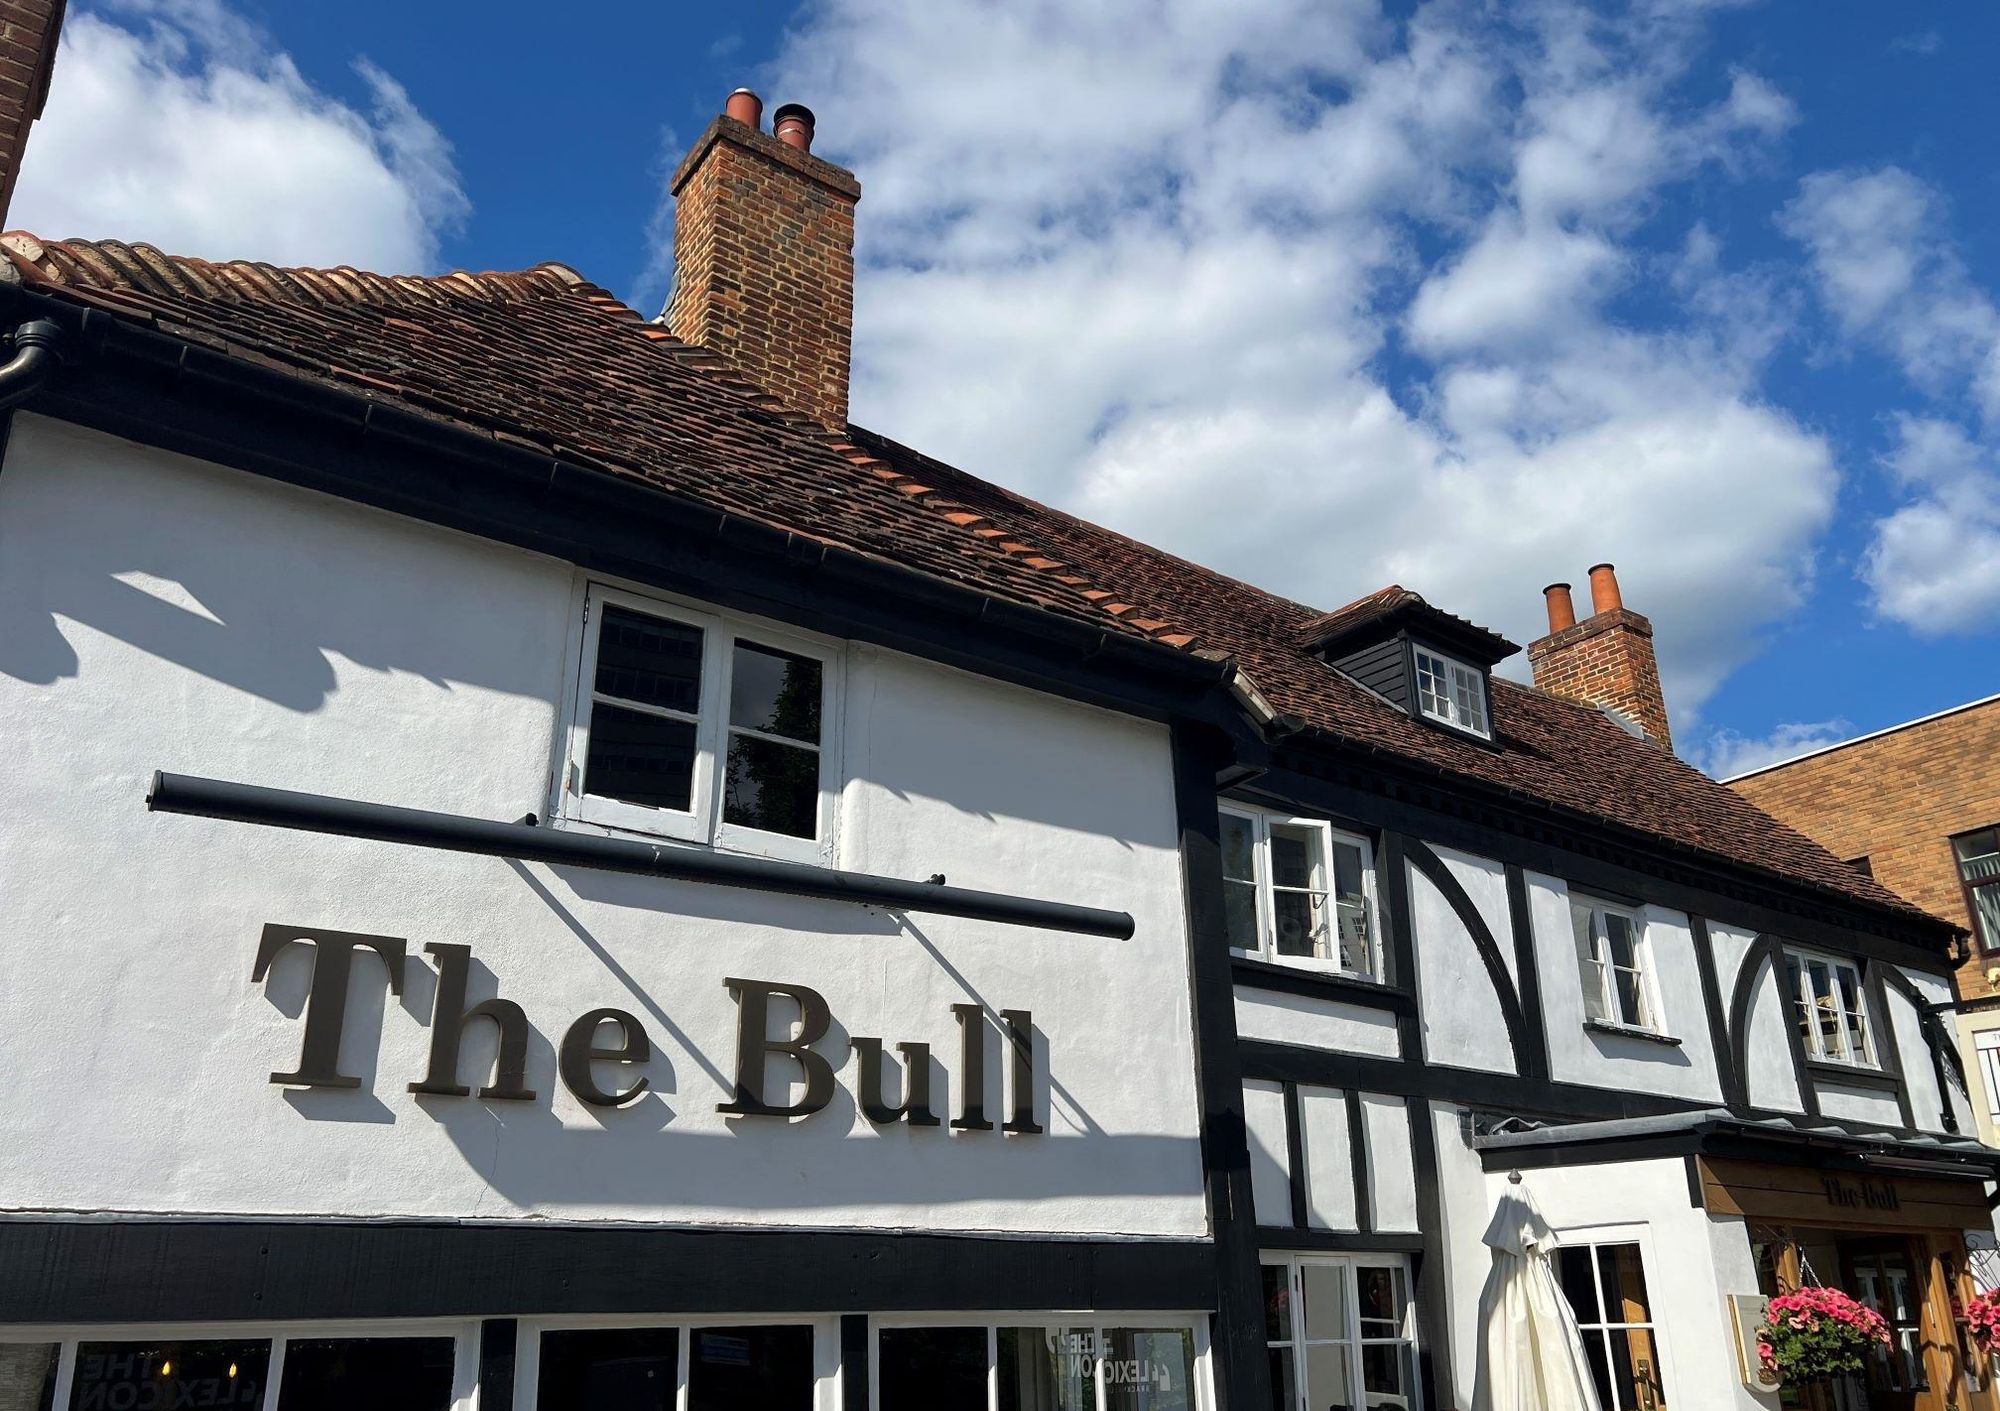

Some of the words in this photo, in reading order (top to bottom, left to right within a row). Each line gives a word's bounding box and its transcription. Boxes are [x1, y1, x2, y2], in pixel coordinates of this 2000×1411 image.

[251, 922, 650, 1107] The
[715, 976, 1044, 1135] Bull
[1821, 1176, 1859, 1208] The
[1861, 1181, 1899, 1210] Bull
